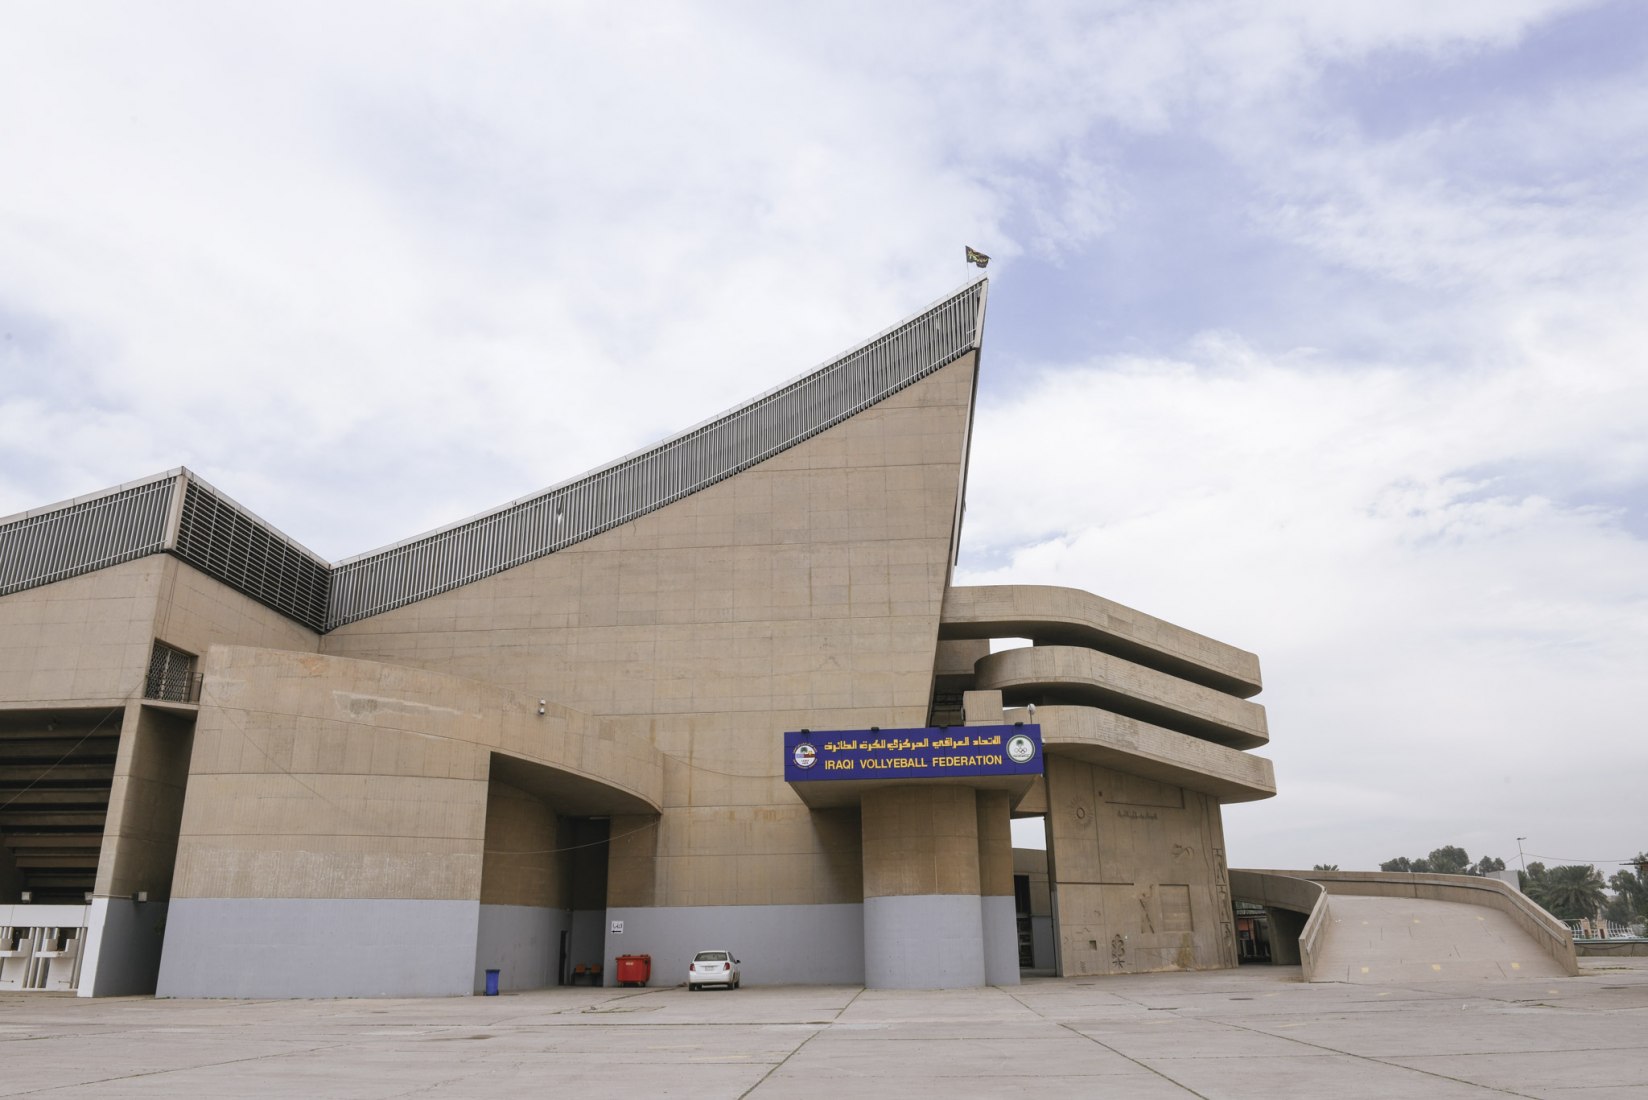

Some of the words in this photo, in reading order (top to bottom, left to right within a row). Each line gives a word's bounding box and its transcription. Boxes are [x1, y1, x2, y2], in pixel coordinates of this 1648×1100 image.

[824, 740, 858, 752] الطائرة
[887, 738, 928, 751] المركزي
[932, 736, 970, 749] العراقي
[824, 760, 854, 770] IRAQI
[860, 758, 928, 769] VOLLYEBALL
[932, 755, 1002, 767] FEDERATION
